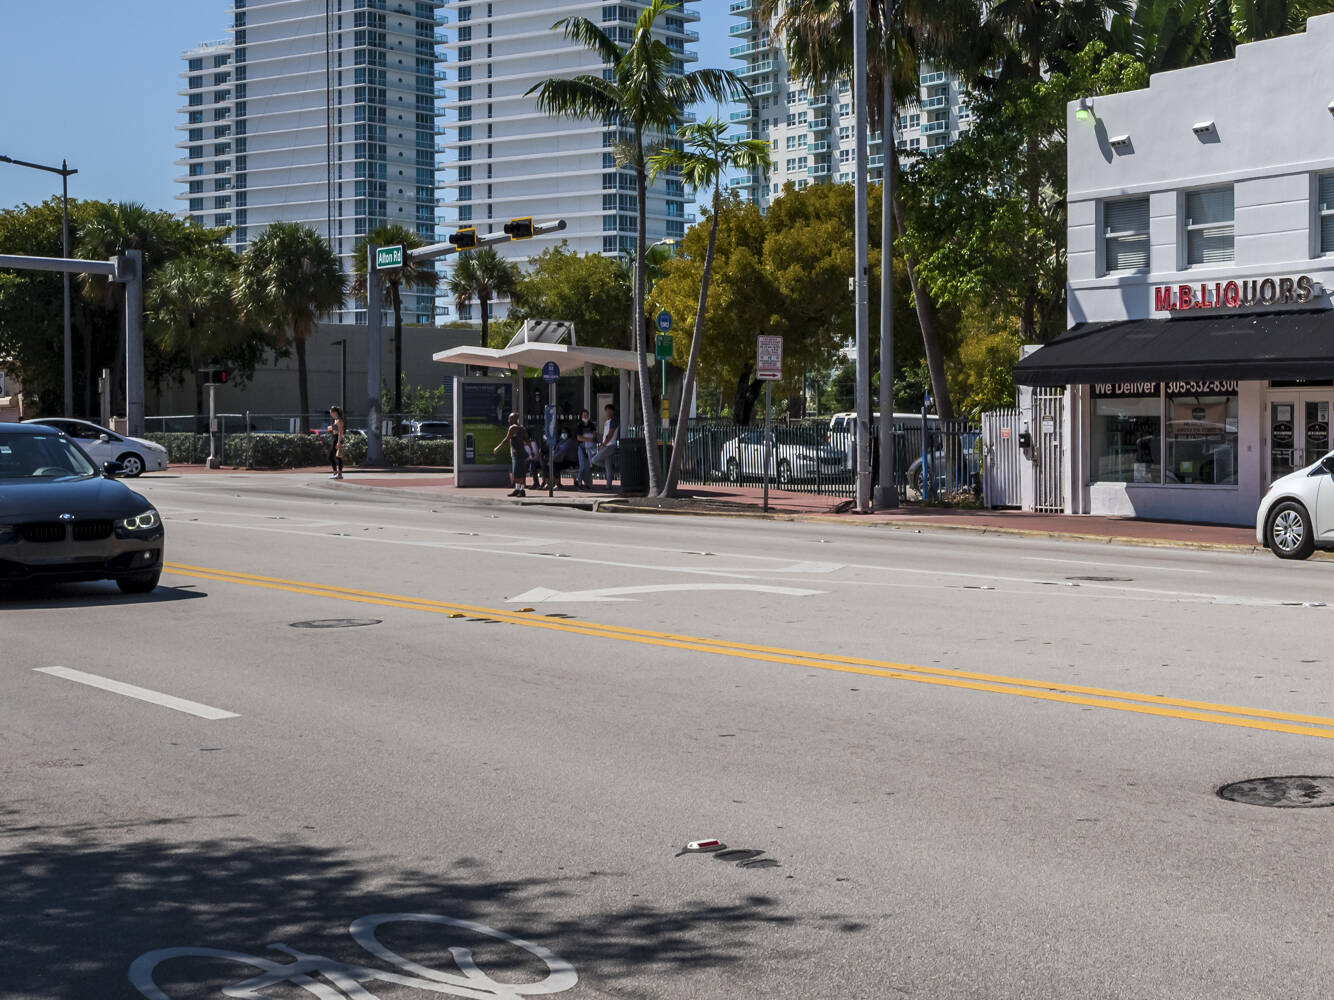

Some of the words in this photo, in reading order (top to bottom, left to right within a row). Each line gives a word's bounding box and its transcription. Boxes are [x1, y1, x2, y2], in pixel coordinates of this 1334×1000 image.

[379, 252, 392, 265] Alton
[393, 250, 401, 262] Rd
[1095, 383, 1112, 394] We
[1115, 382, 1156, 394] Deliver
